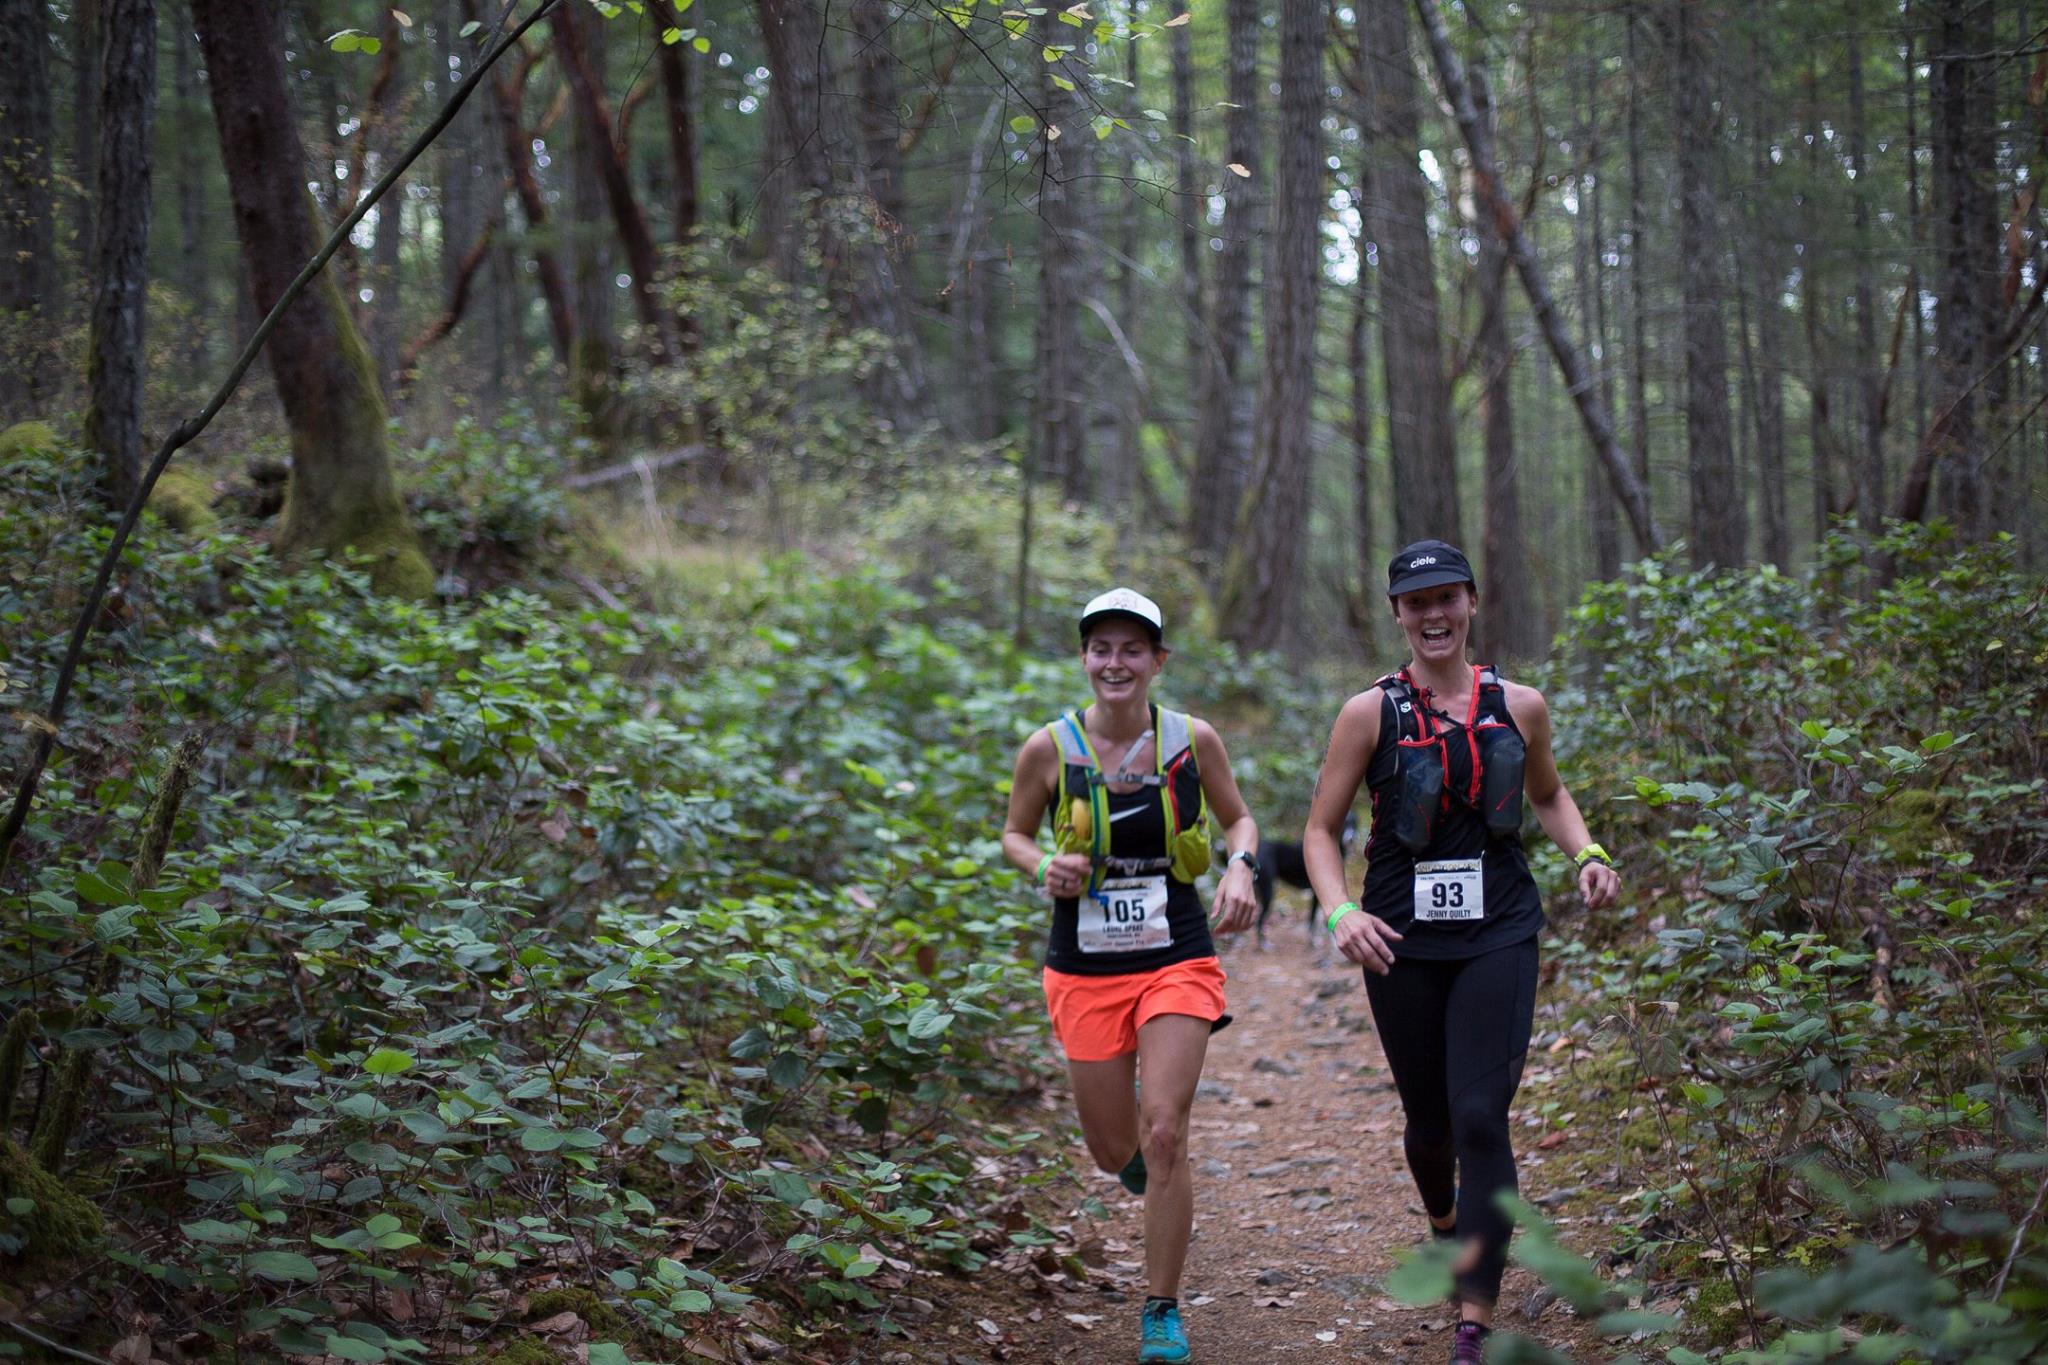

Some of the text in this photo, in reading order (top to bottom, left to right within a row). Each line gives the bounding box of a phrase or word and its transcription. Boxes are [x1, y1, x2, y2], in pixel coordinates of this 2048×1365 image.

[1410, 556, 1437, 569] ciele
[1431, 881, 1464, 908] 93
[1103, 898, 1145, 923] 105
[1426, 909, 1471, 918] JENNY QUILTY
